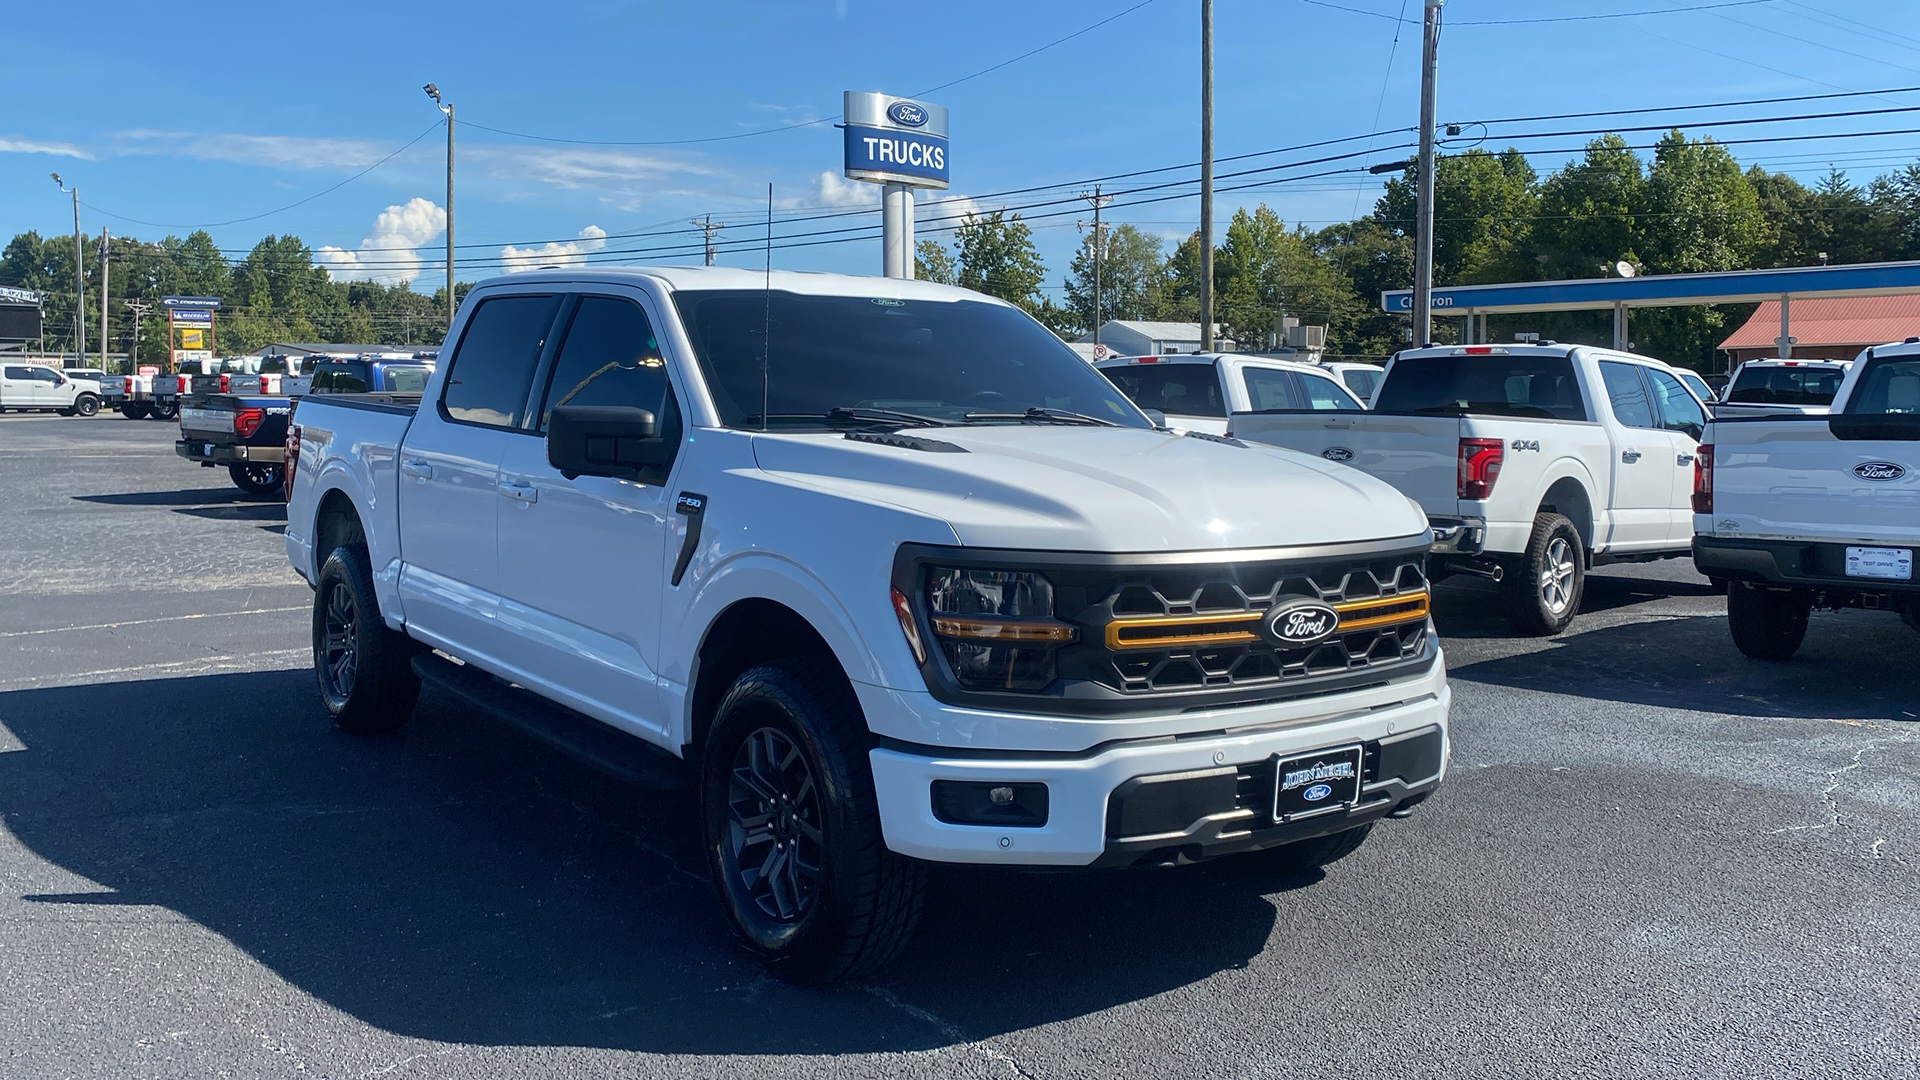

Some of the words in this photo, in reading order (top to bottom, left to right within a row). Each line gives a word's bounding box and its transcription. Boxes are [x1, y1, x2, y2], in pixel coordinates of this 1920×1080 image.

[899, 105, 921, 123] Ford
[863, 137, 945, 170] TRUCKS
[1400, 296, 1453, 308] Chron
[1326, 449, 1349, 460] Ford
[1861, 464, 1895, 478] Ford
[1284, 610, 1327, 637] Ford
[1282, 768, 1315, 789] JOHN
[1315, 762, 1355, 779] MEGEL
[1308, 786, 1326, 799] Ford
